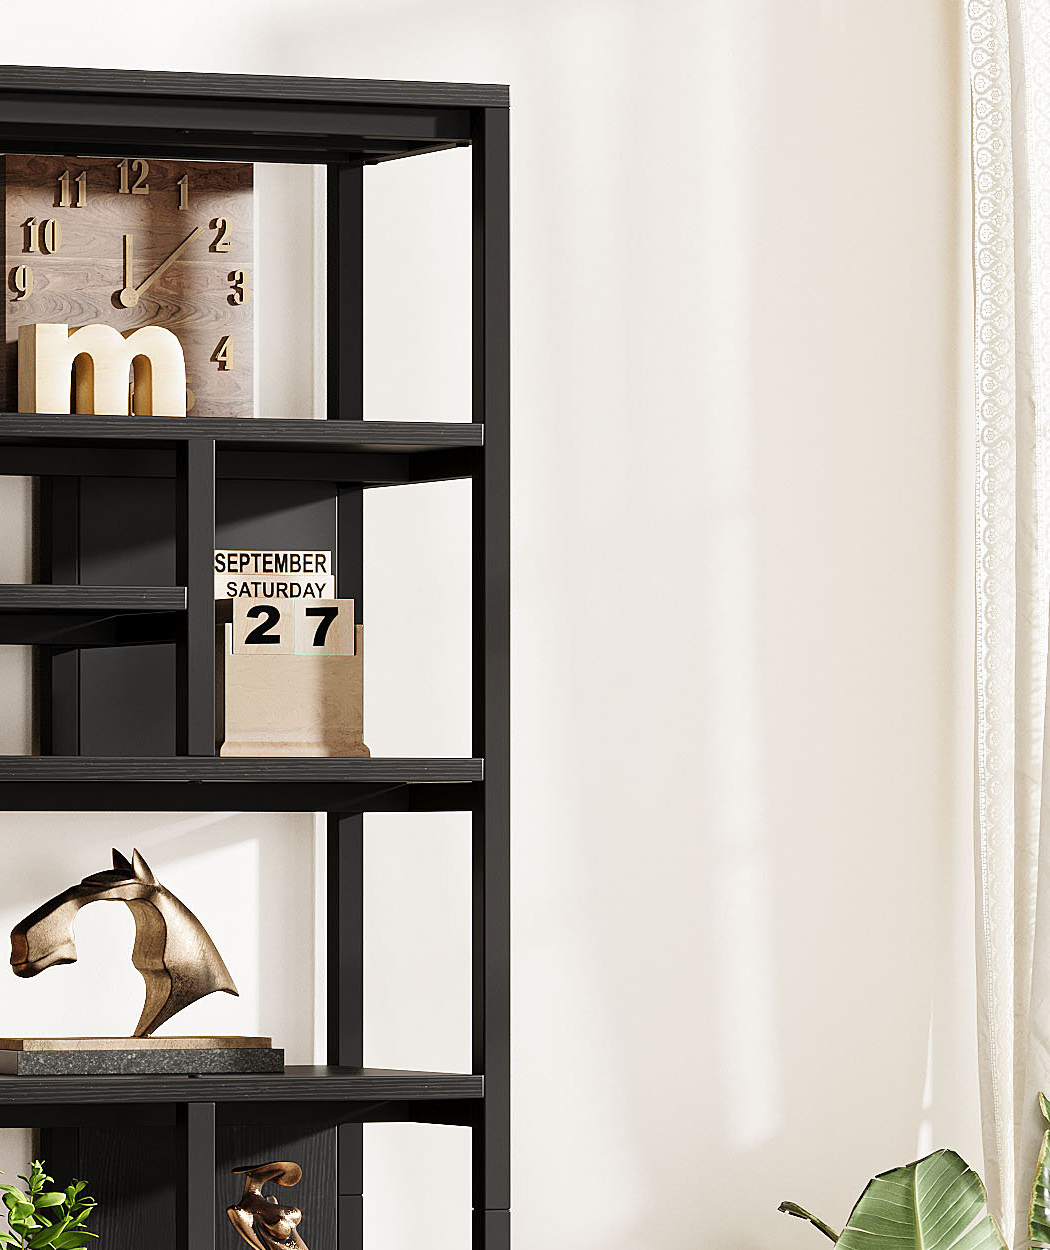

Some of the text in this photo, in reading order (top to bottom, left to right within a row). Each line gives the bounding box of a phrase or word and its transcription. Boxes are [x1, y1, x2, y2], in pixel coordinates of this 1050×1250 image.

[55, 170, 87, 208] 11
[117, 159, 149, 194] 12
[177, 175, 189, 211] 1
[22, 216, 62, 254] 10
[210, 217, 233, 252] 2
[11, 265, 33, 301] 9
[228, 270, 250, 305] 3
[30, 323, 186, 417] m
[211, 335, 234, 370] 4
[215, 553, 327, 573] SEPTEMBER
[226, 581, 326, 598] SATURDAY
[244, 605, 339, 646] 2 7
